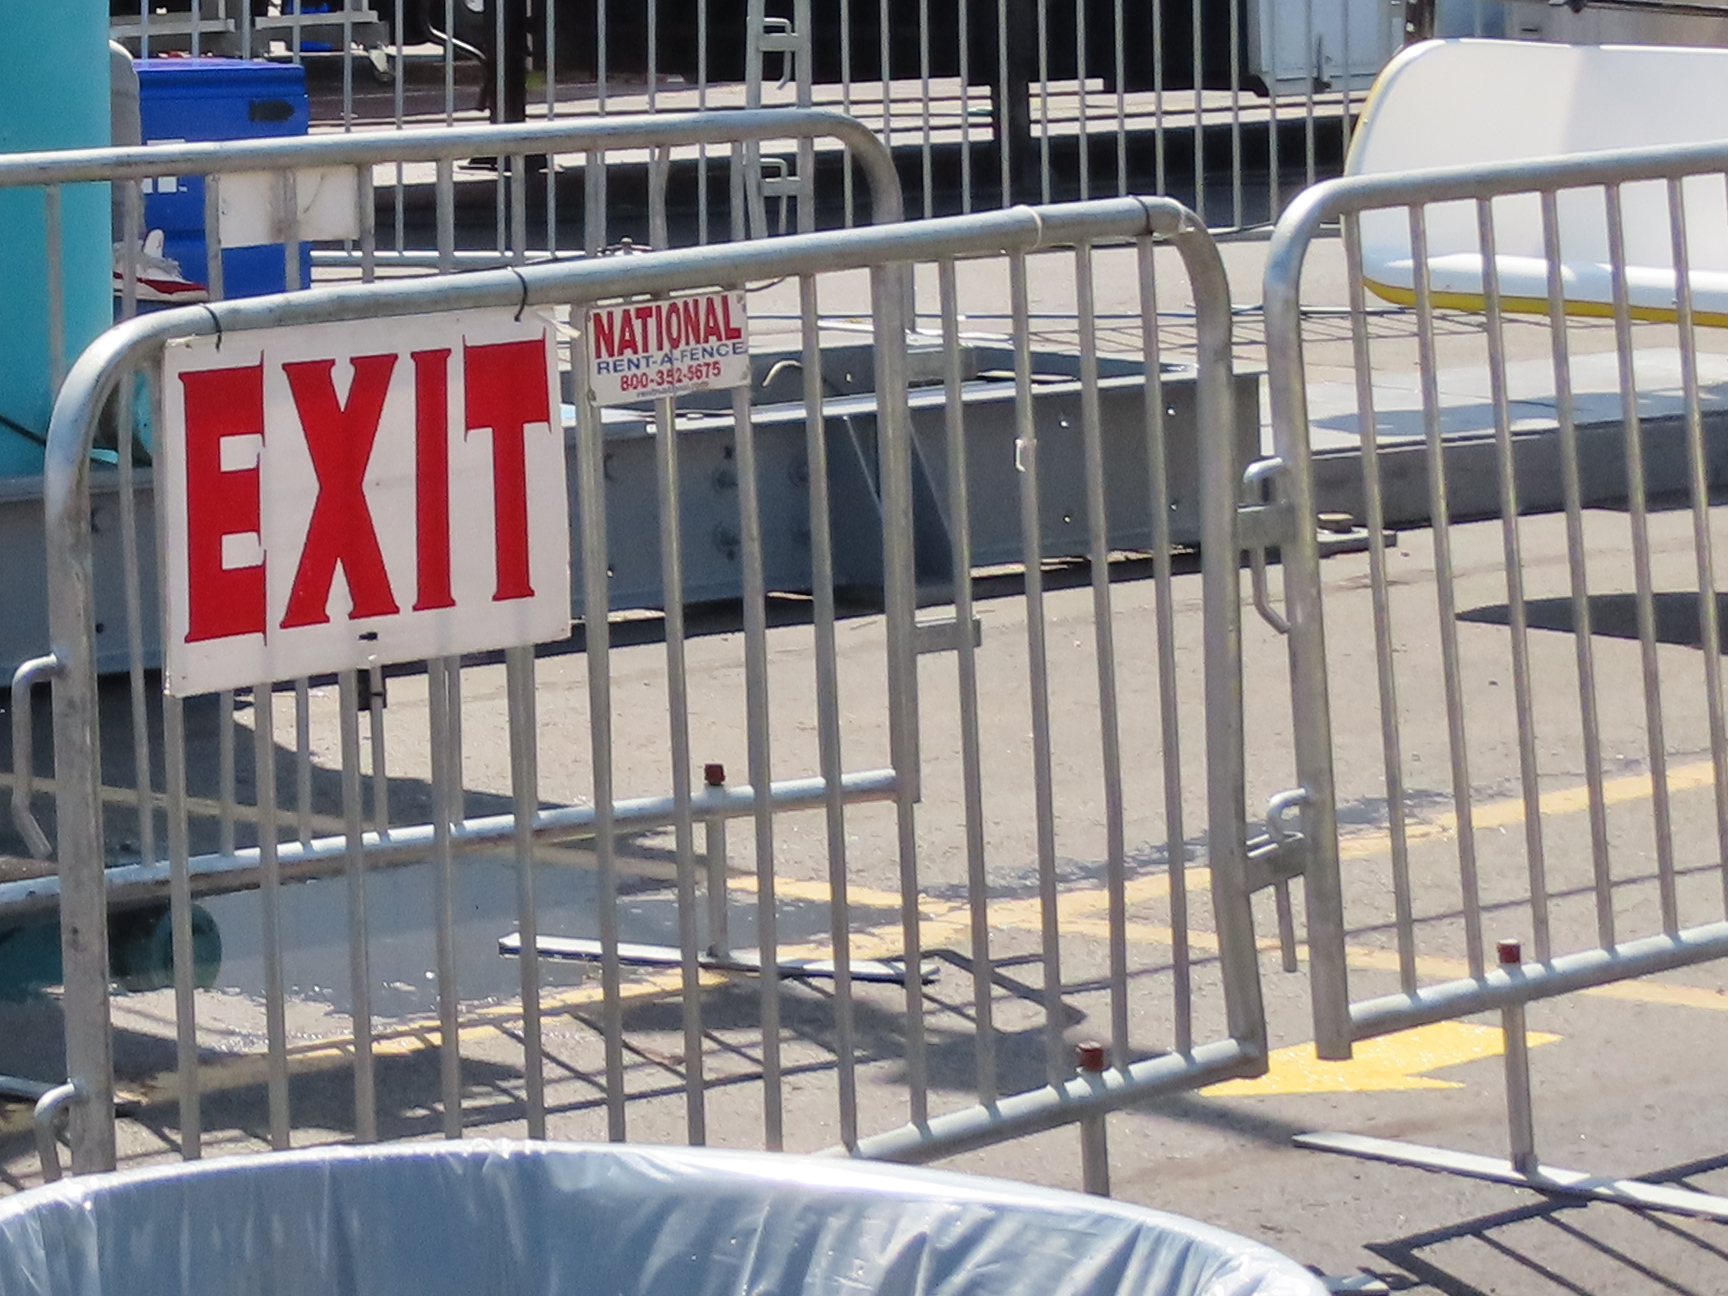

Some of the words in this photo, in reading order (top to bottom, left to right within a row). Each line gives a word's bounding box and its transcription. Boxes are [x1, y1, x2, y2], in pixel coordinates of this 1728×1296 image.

[595, 295, 742, 359] NATIONAL
[597, 342, 748, 375] RENT-A-FENCE
[620, 361, 722, 392] 800-352-5675
[179, 330, 552, 646] EXIT
